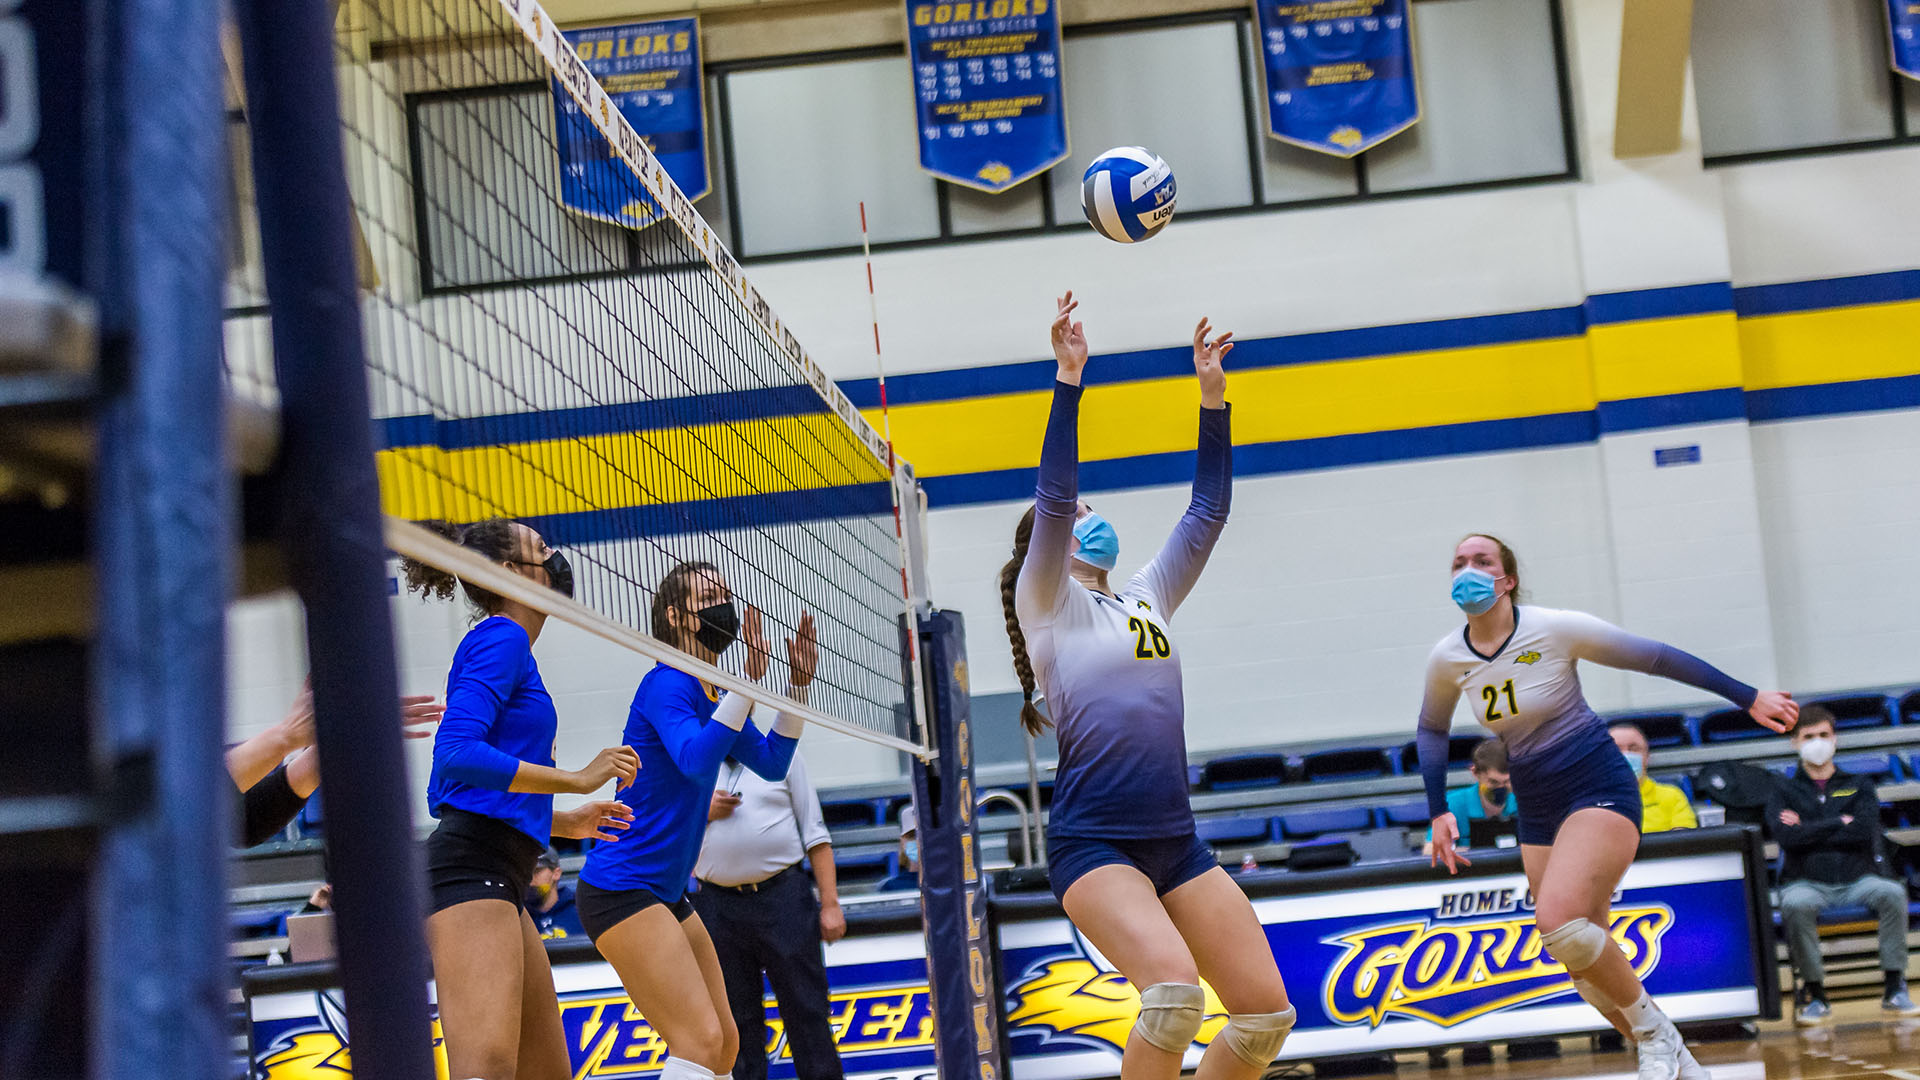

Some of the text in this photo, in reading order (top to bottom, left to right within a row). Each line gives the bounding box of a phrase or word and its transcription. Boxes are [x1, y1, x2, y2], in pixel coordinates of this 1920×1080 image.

[914, 0, 1048, 26] GORLOKS
[929, 17, 1038, 38] WOMENS SOCCER
[573, 31, 689, 60] ORLOKS
[1482, 678, 1519, 722] 21
[1437, 887, 1517, 918] HOME
[1326, 905, 1672, 1028] GORLS
